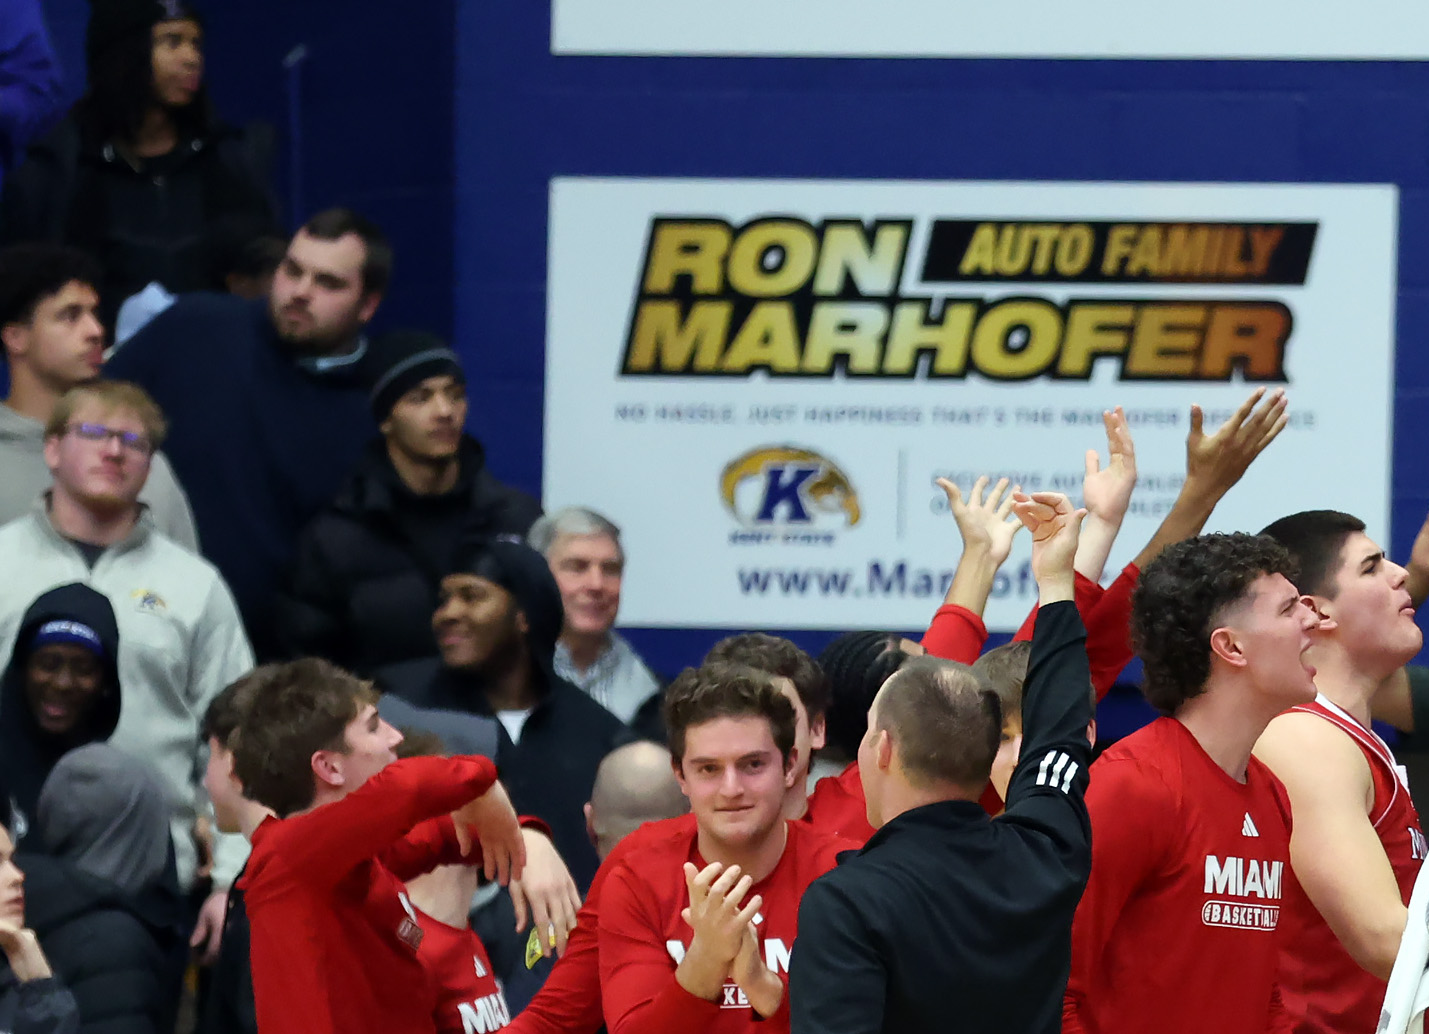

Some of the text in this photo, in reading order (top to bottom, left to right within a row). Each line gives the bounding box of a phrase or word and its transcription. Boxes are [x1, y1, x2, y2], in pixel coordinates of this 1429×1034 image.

[640, 219, 912, 298] RON
[958, 221, 1287, 278] AUTO FAMILY
[624, 299, 1290, 380] MARHOFER
